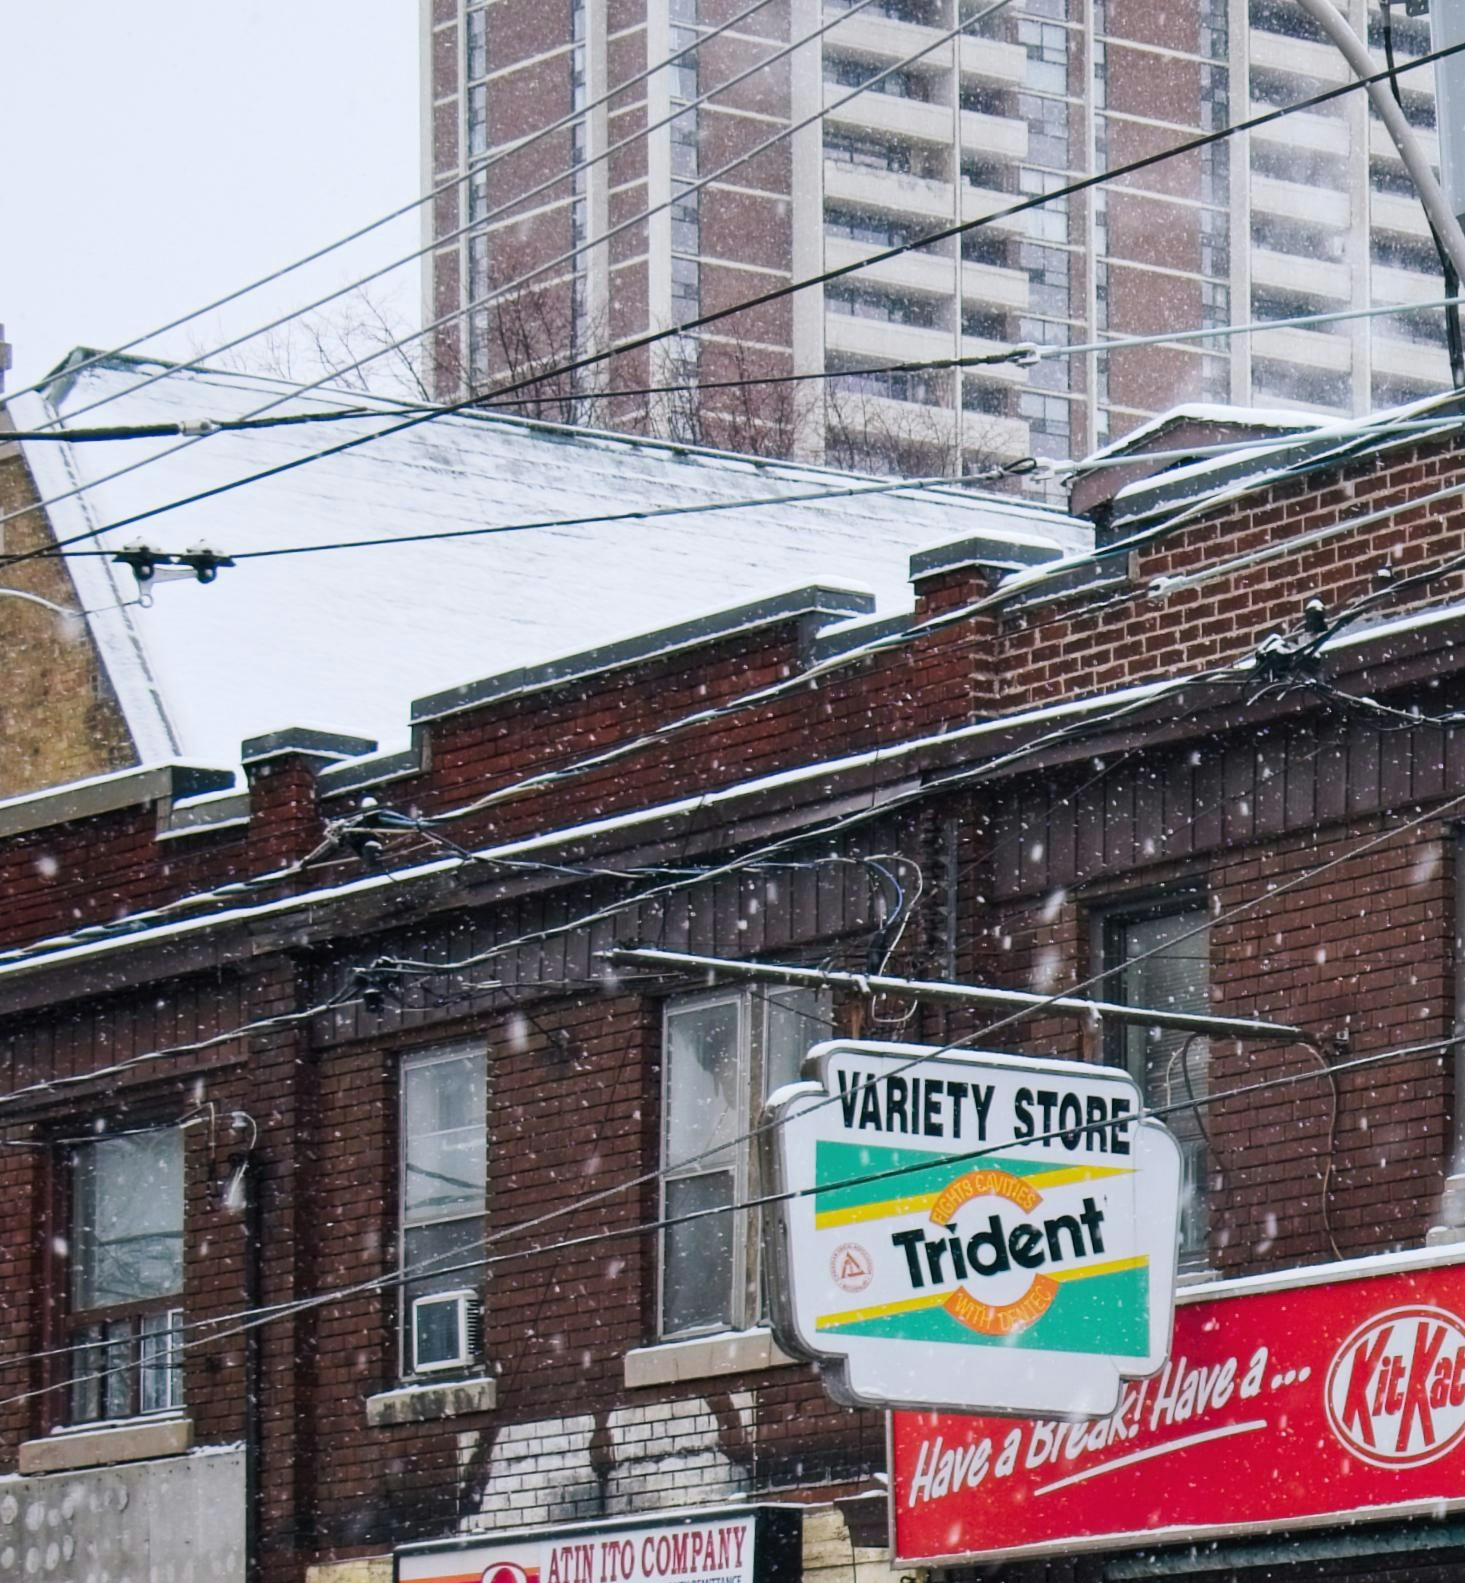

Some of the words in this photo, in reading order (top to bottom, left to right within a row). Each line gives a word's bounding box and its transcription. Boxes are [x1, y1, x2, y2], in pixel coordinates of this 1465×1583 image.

[837, 1069, 995, 1142] VARIETY
[1014, 1086, 1131, 1155] STORE
[974, 1171, 1037, 1210] CAVITIES
[891, 1197, 1103, 1289] Trident
[954, 1291, 994, 1330] WITH
[909, 1436, 989, 1508] Have
[994, 1434, 1017, 1476] a
[1030, 1379, 1144, 1470] Break!
[1151, 1357, 1238, 1432] Have
[600, 1540, 635, 1583] ITO
[641, 1525, 747, 1577] COMPANY
